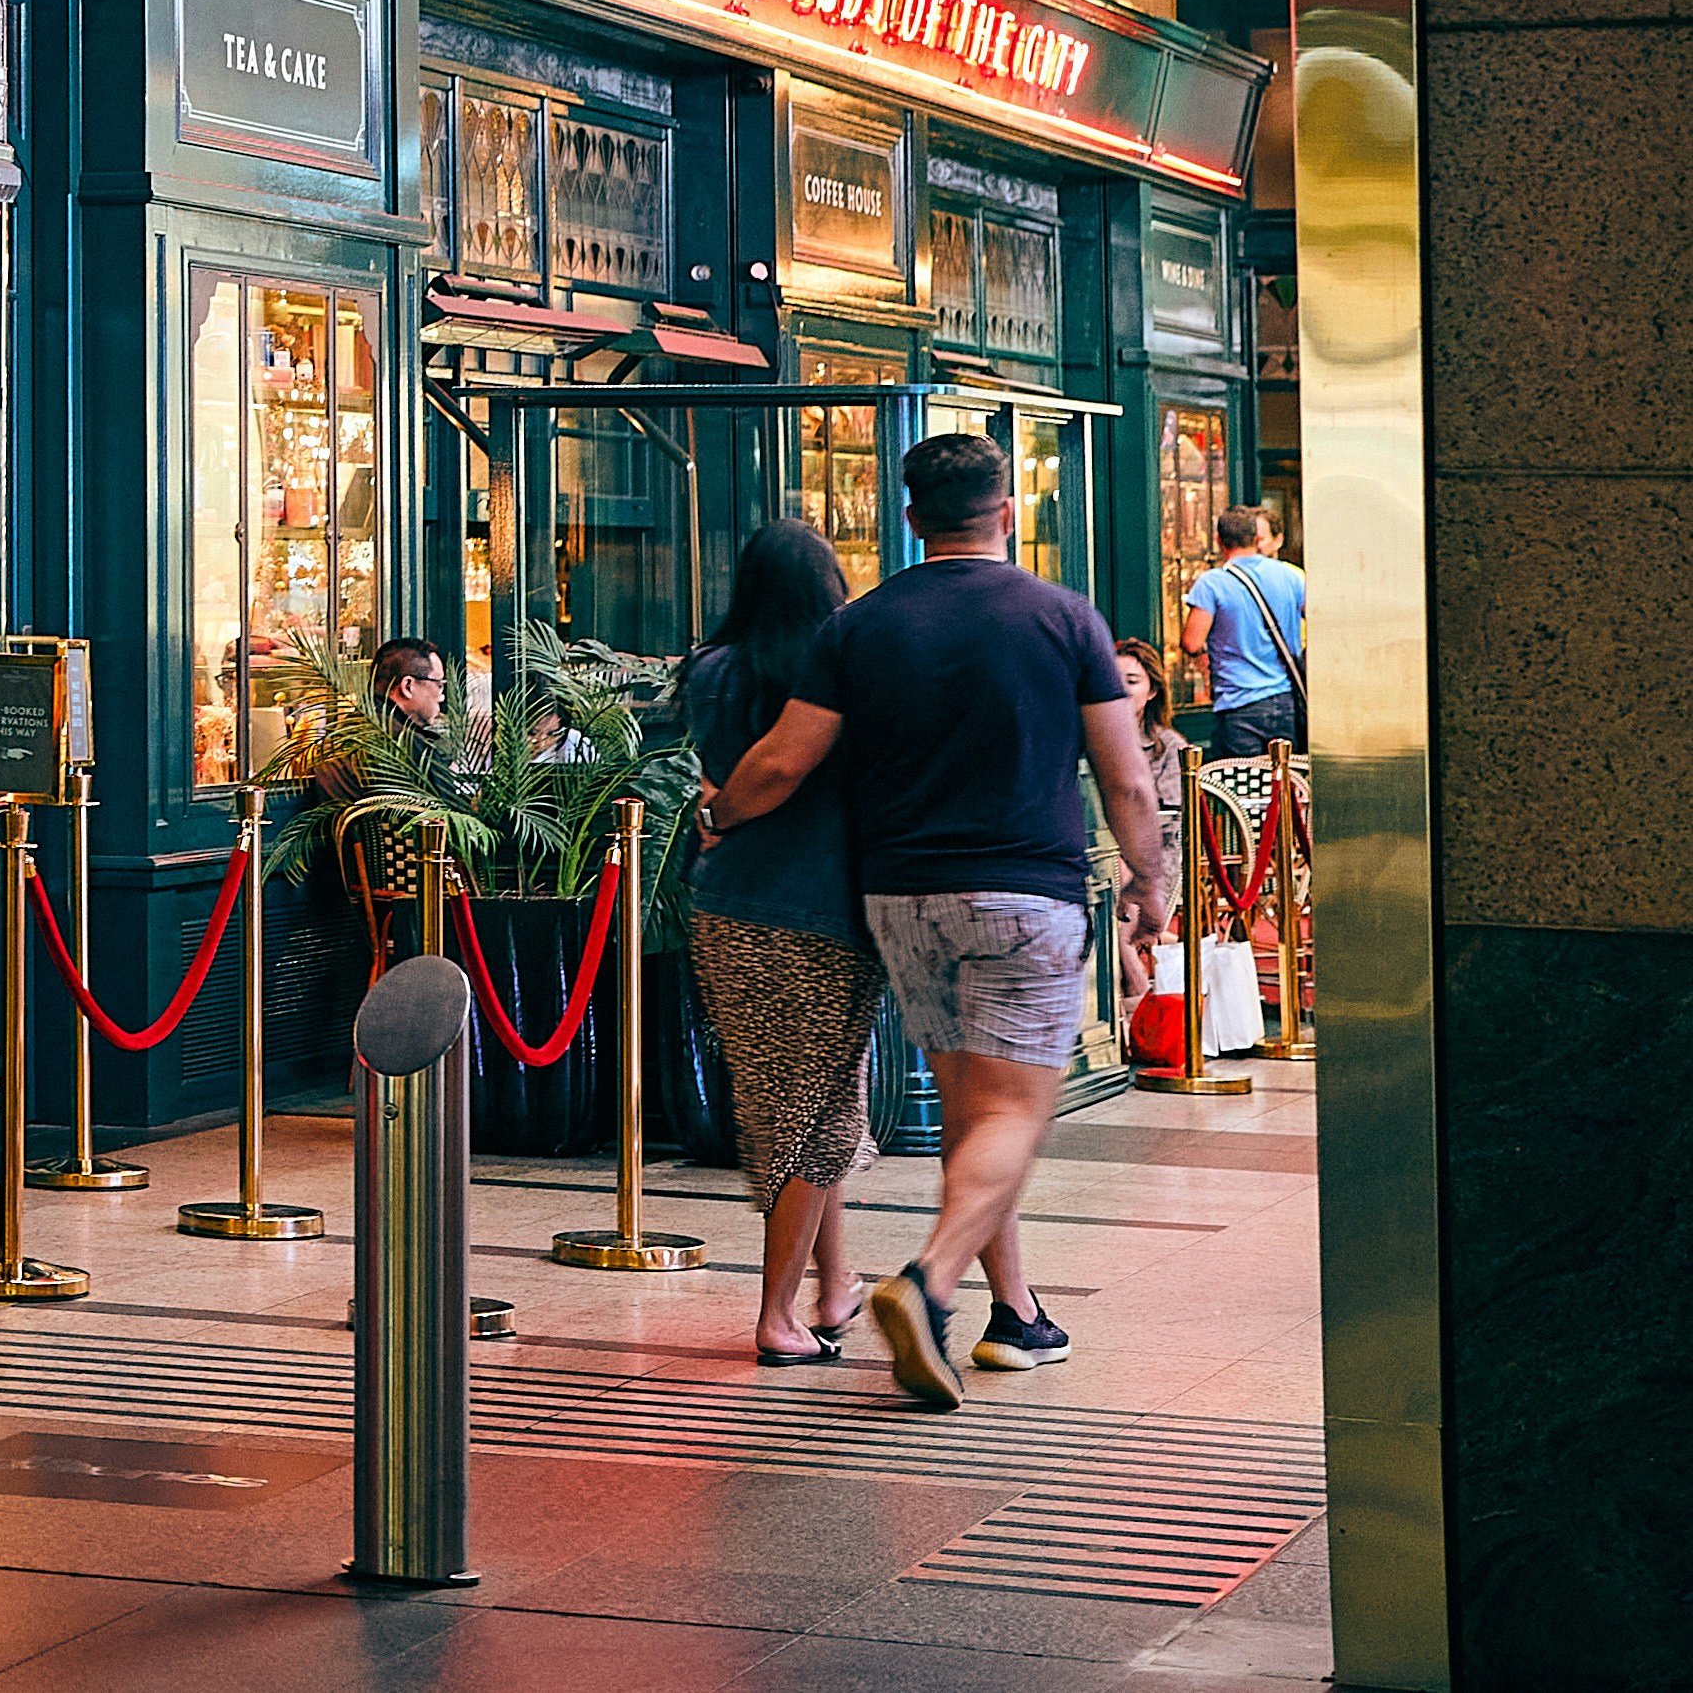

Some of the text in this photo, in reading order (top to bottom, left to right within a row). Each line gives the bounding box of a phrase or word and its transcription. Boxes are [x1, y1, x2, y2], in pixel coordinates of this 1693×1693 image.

[223, 32, 327, 90] TEA & CAKE
[1022, 24, 1090, 96] CITY
[804, 173, 883, 218] COFFEE HOUSE
[15, 726, 37, 738] WAY
